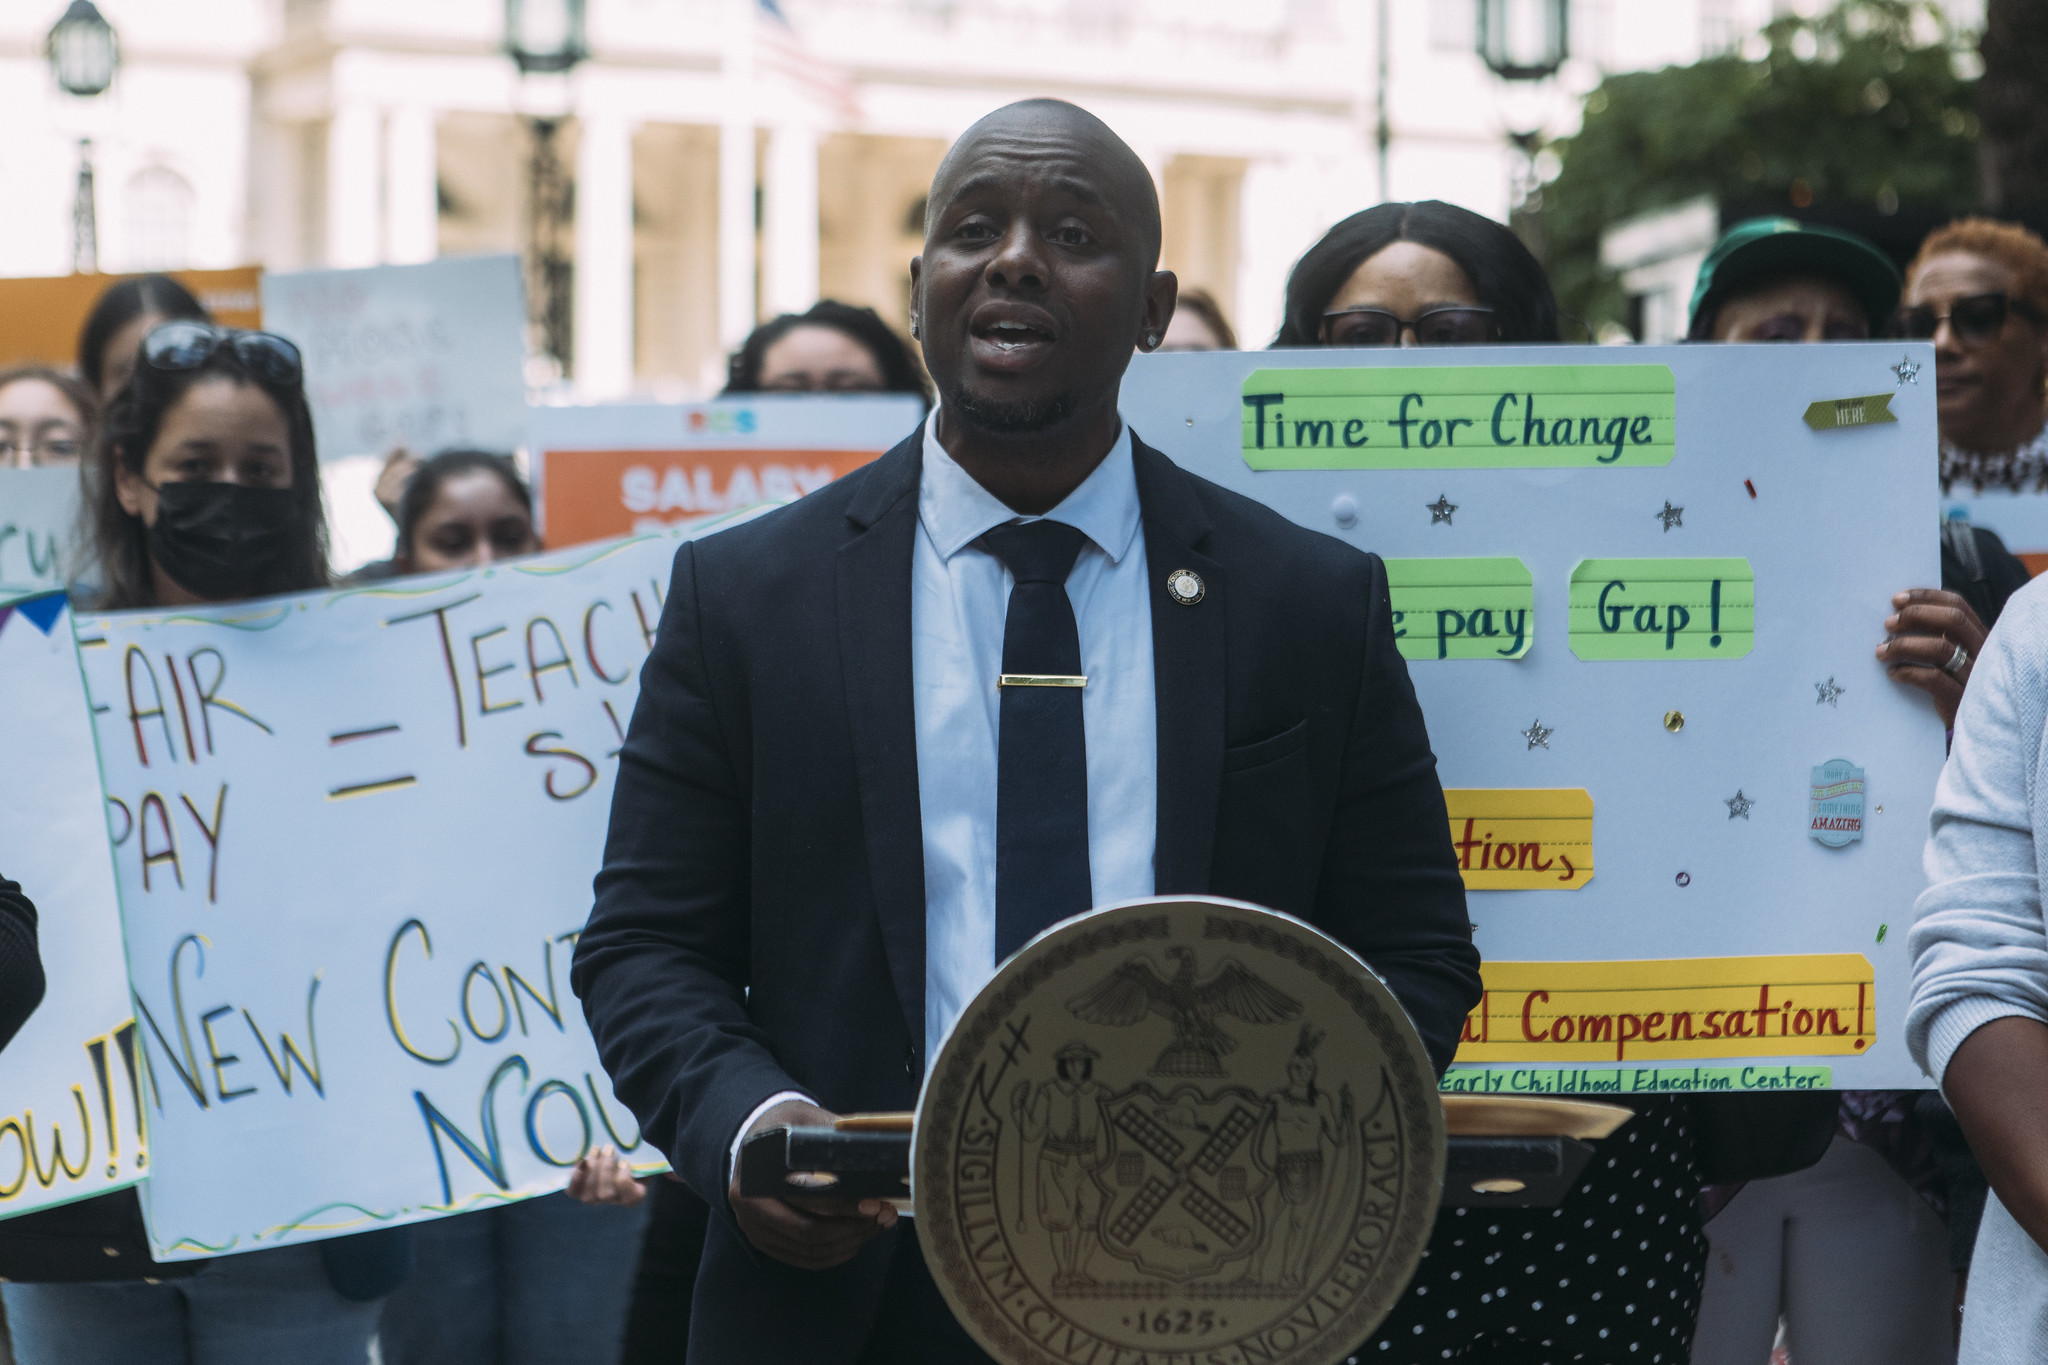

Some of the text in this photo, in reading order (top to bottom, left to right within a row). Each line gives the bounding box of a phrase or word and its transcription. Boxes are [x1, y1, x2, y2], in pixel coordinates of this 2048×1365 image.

[1243, 393, 1652, 464] Time for Change
[1437, 608, 1525, 660] pay
[1598, 579, 1722, 651] Gap!
[1811, 817, 1861, 832] AMAZING
[1818, 803, 1861, 815] SOMETHING
[1457, 818, 1575, 881] tion,
[133, 932, 327, 1120] NEW
[1521, 982, 1866, 1062] Compensation!
[1438, 1065, 1825, 1093] Early Childhood Education Center.
[959, 1124, 1030, 1304] SIGILLVM
[1234, 1292, 1340, 1365] NOVI
[1338, 1131, 1398, 1299] EBORACI
[1134, 1308, 1215, 1335] 1625
